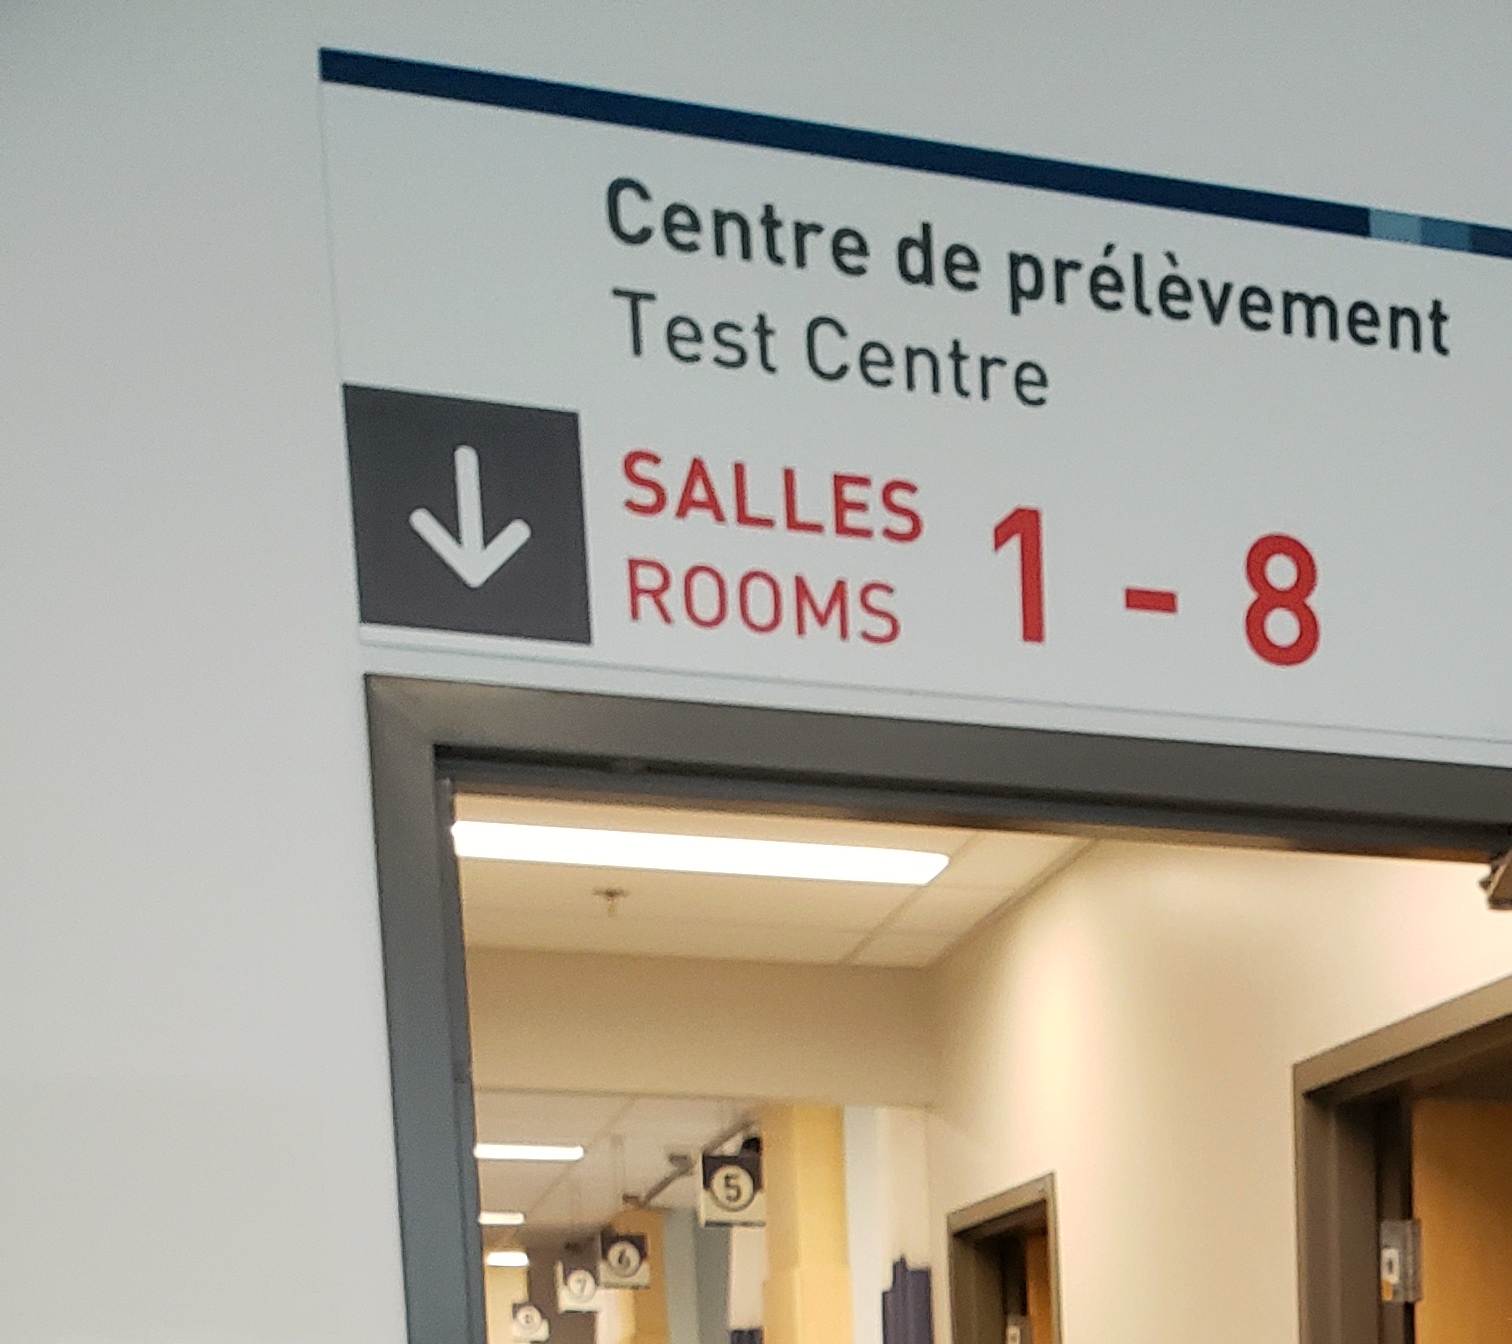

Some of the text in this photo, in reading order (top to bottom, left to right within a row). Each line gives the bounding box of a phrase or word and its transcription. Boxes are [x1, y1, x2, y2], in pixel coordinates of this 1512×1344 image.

[606, 177, 1450, 357] Centre de prélèvement
[611, 288, 1050, 407] Test Centre
[622, 448, 923, 544] SALLES
[626, 557, 901, 646] ROOMS
[993, 506, 1047, 644] 1
[1245, 532, 1321, 667] 8
[724, 1173, 742, 1203] 5
